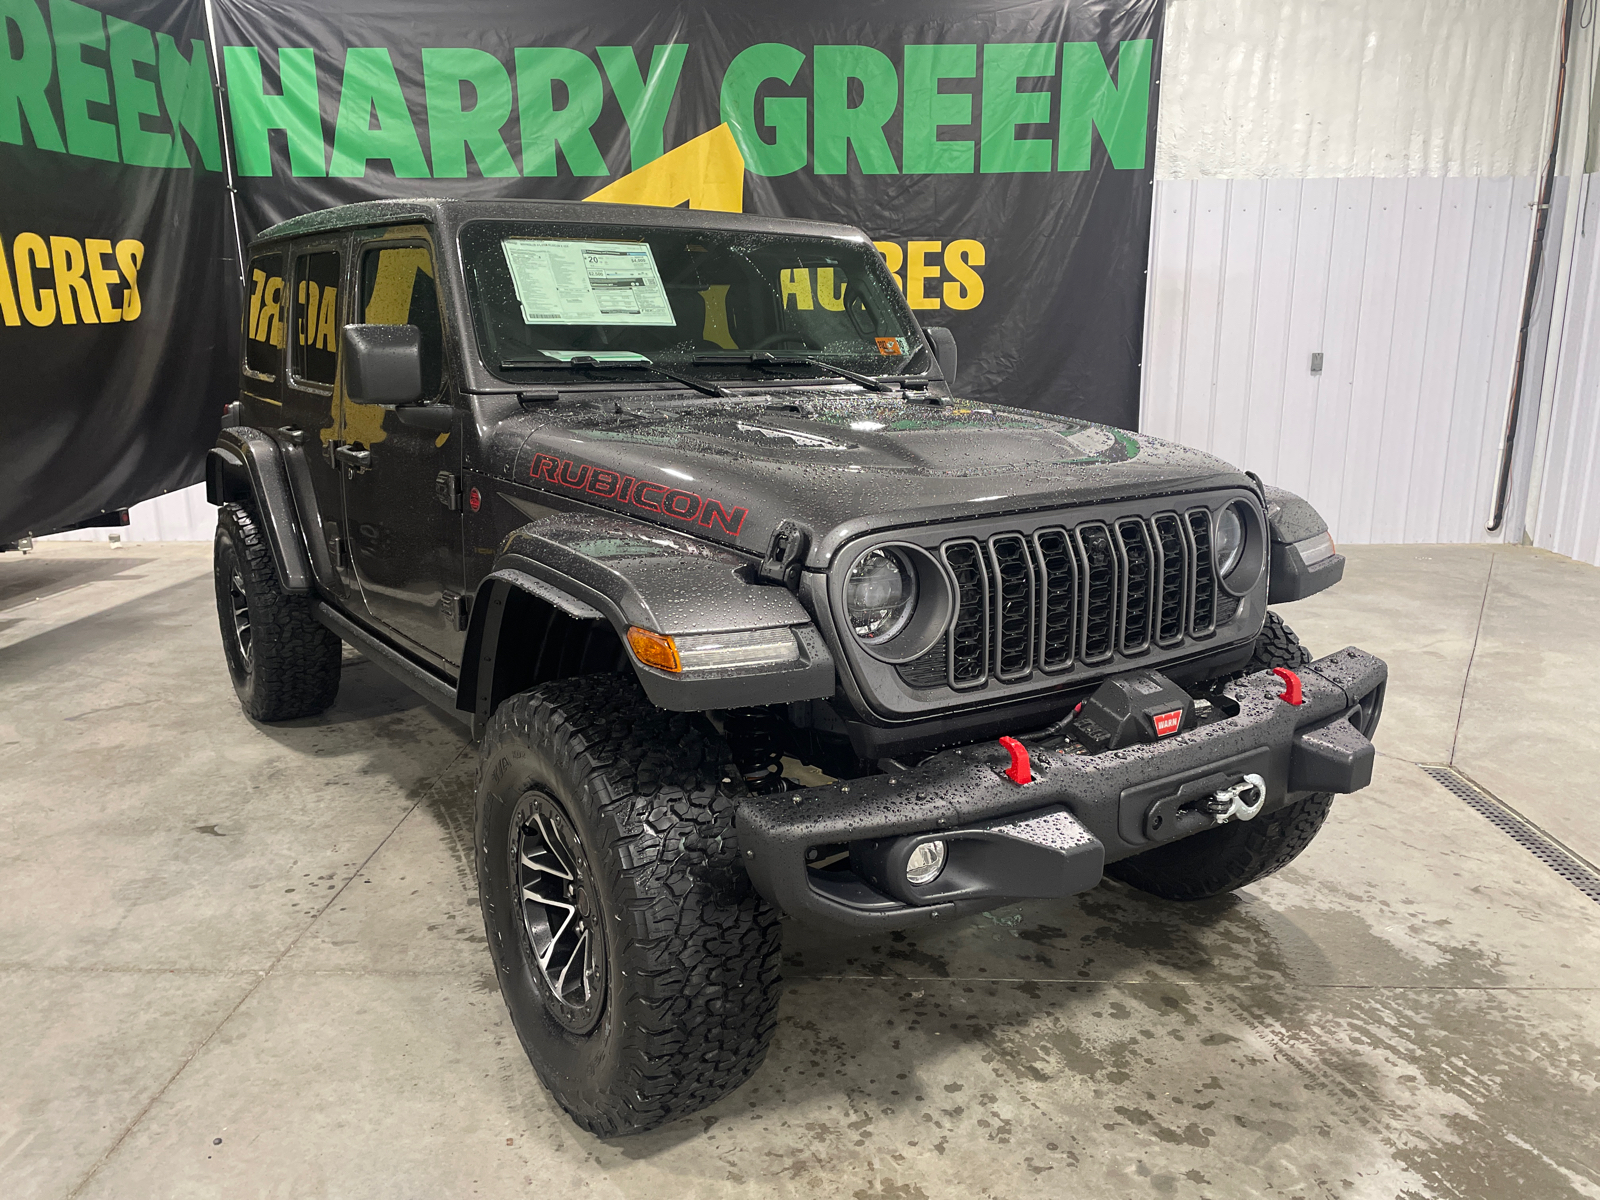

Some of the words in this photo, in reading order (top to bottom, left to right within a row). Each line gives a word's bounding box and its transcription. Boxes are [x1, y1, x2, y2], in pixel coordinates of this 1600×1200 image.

[223, 43, 688, 178] HARRY
[720, 39, 1153, 176] GREEN
[529, 452, 749, 537] RUBICON
[1158, 718, 1177, 730] WARN
